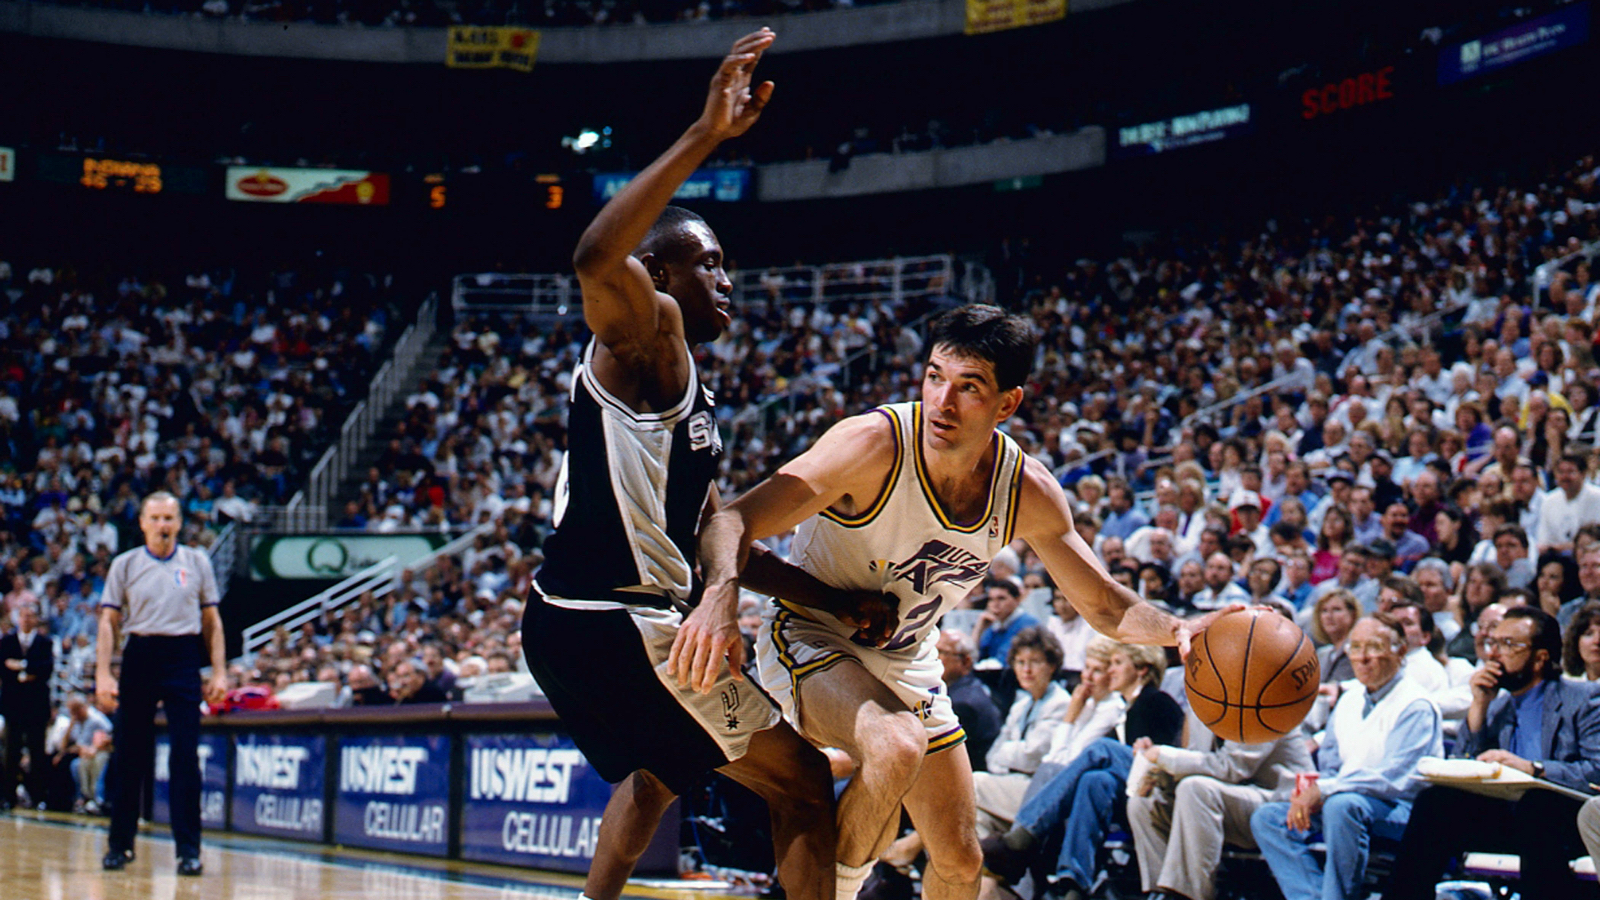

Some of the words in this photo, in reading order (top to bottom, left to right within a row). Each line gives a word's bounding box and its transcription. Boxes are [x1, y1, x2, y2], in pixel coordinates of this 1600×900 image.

[1302, 66, 1394, 119] SCORE
[255, 793, 324, 832] CELLULAR
[364, 800, 445, 843] CELLULAR
